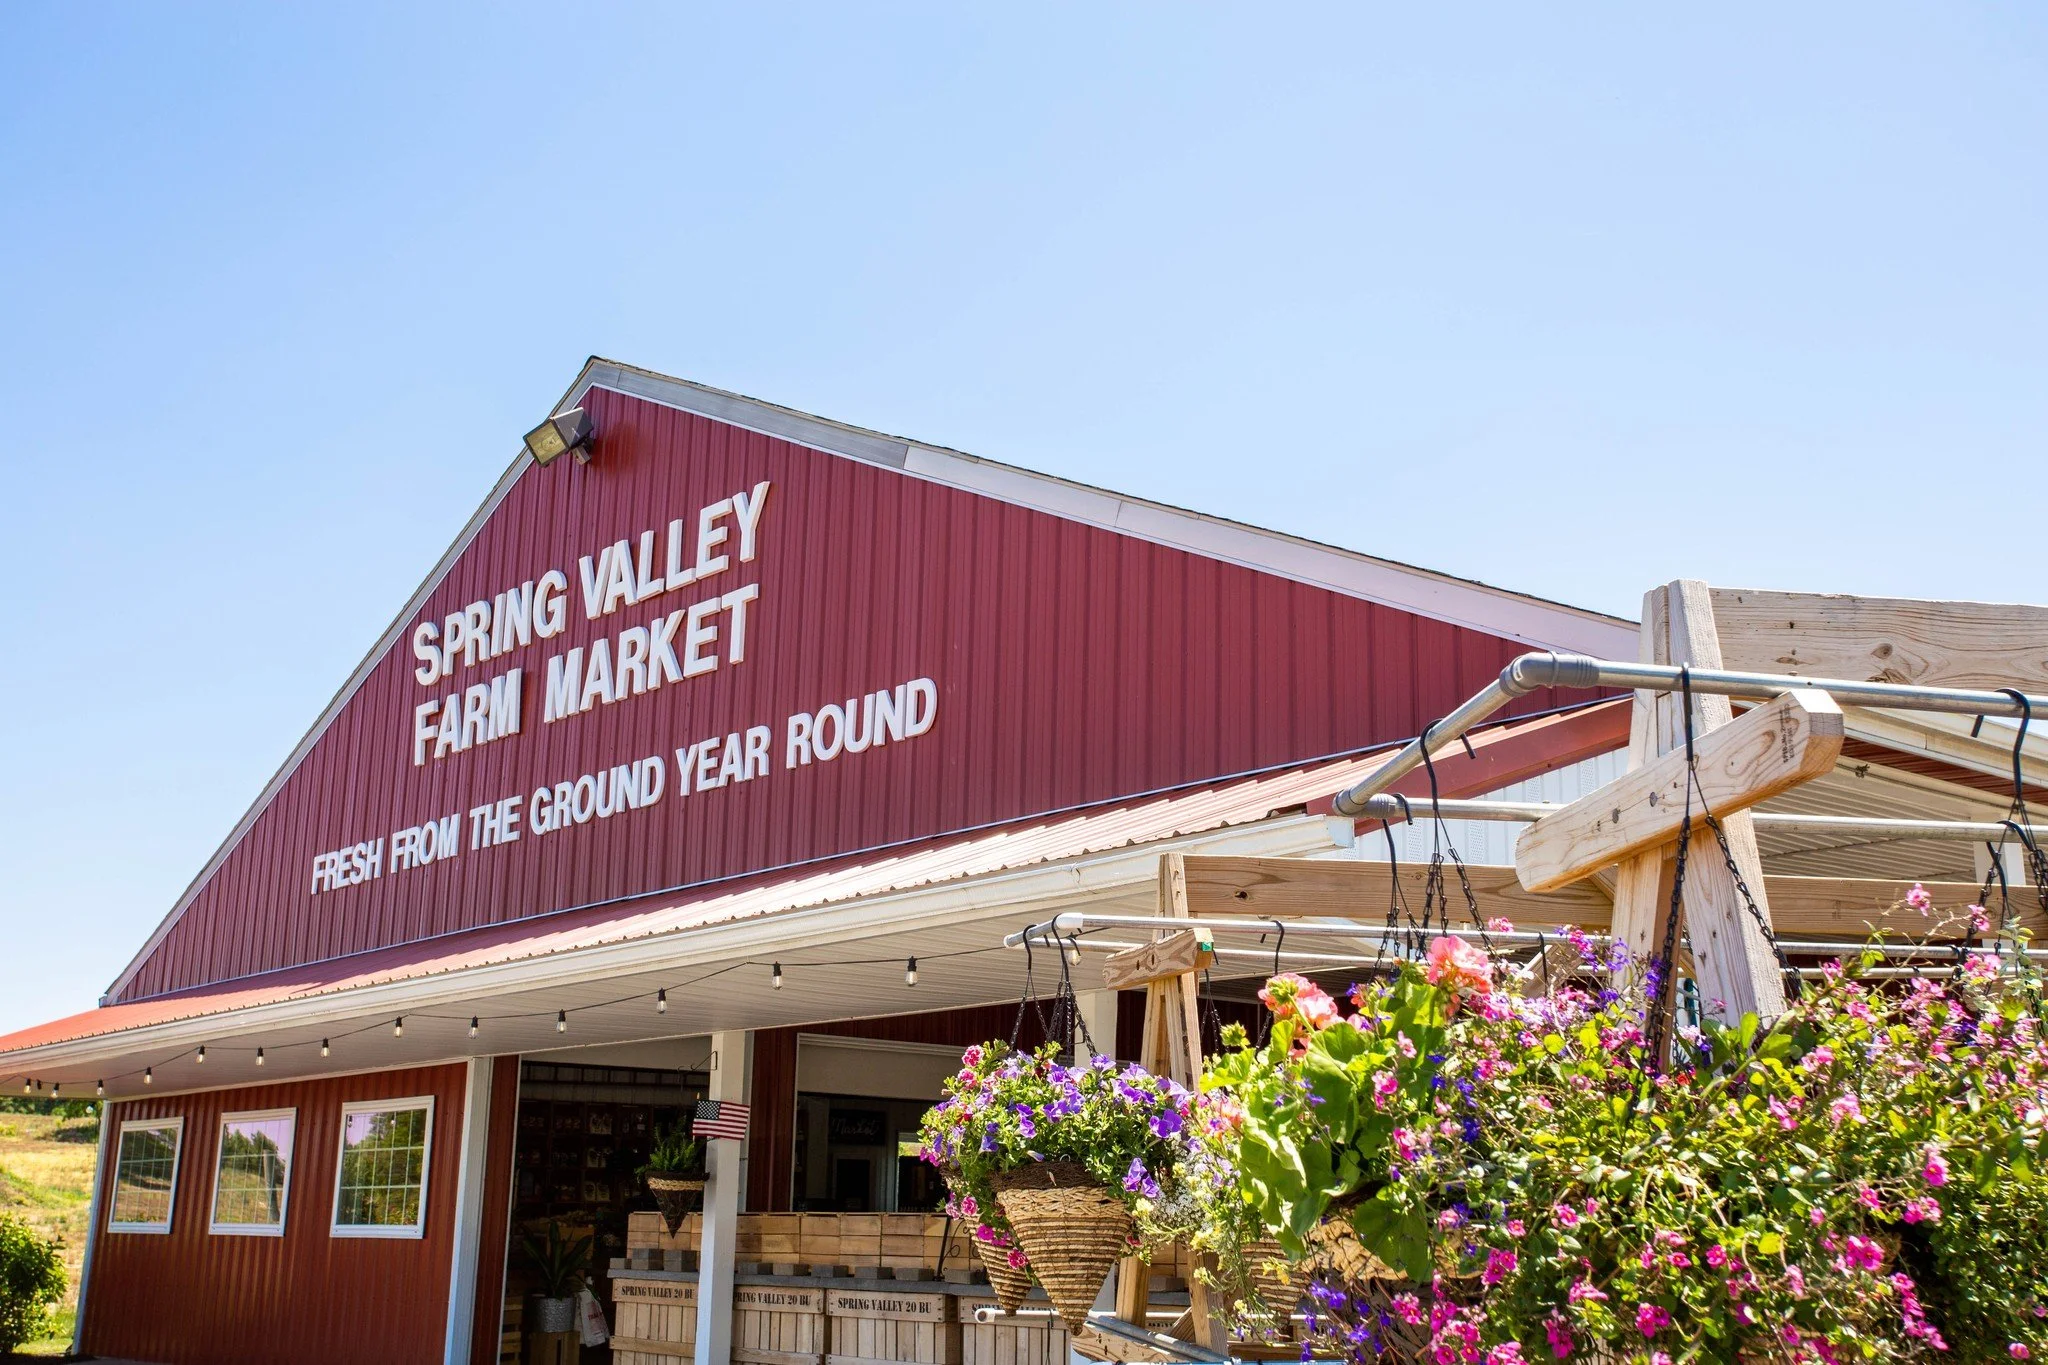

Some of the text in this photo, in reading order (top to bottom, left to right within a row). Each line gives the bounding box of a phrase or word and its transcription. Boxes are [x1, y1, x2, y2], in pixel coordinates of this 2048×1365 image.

[413, 480, 771, 687] SPRING VALLEY
[414, 583, 759, 767] FARM MARKET
[311, 677, 938, 895] FRESH FROM THE GROUND YEAR ROUND
[621, 1285, 696, 1300] SPRING VALLEY 20 BU
[734, 1291, 812, 1306] PRING VALLEY 20 BU
[837, 1297, 932, 1314] SPRING VALLEY 20 BU
